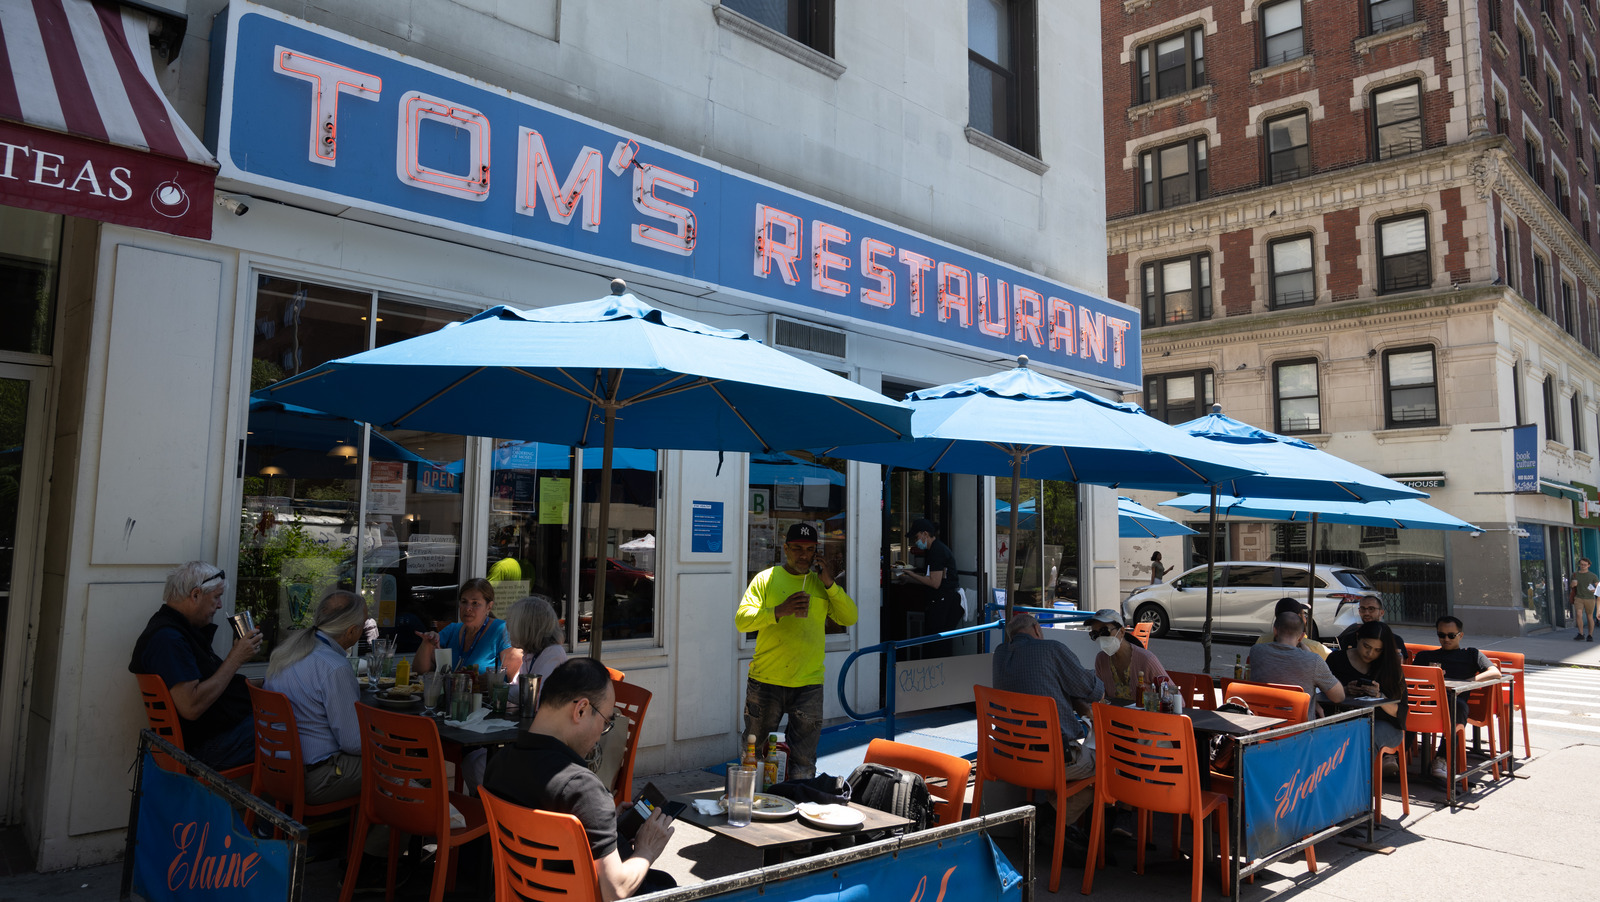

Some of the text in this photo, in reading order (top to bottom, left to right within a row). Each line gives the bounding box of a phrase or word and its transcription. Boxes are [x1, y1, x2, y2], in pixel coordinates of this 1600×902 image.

[0, 142, 133, 201] TEAS
[273, 44, 1131, 369] TOM'S RESTAURANT
[1516, 451, 1530, 459] book
[1516, 460, 1536, 468] culture
[423, 470, 454, 488] OPEN
[1408, 480, 1439, 488] HOUSE
[754, 493, 765, 514] B
[167, 821, 262, 892] Elaine
